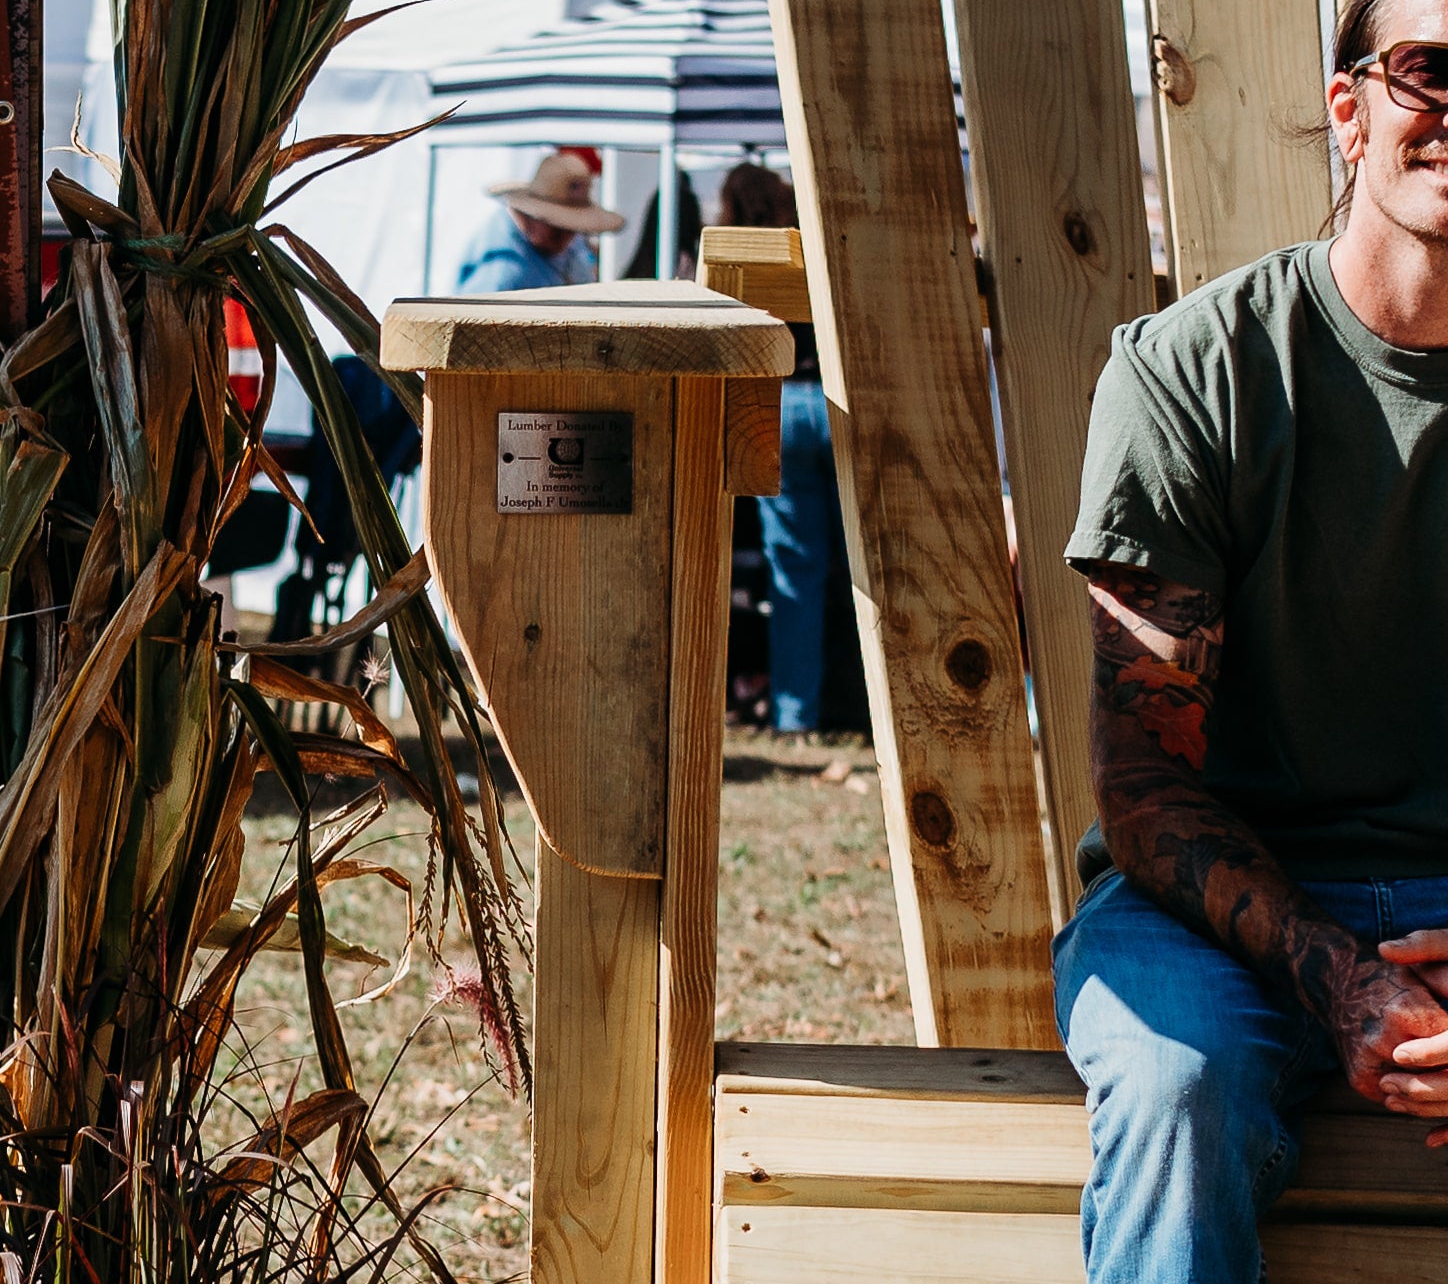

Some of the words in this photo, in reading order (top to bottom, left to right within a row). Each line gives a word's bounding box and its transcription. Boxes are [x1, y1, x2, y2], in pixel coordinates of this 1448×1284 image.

[507, 419, 553, 432] Lumber
[556, 419, 605, 432] Donated
[526, 480, 539, 492] In
[542, 482, 590, 495] memory
[592, 481, 605, 492] of
[500, 495, 542, 510] Joseph
